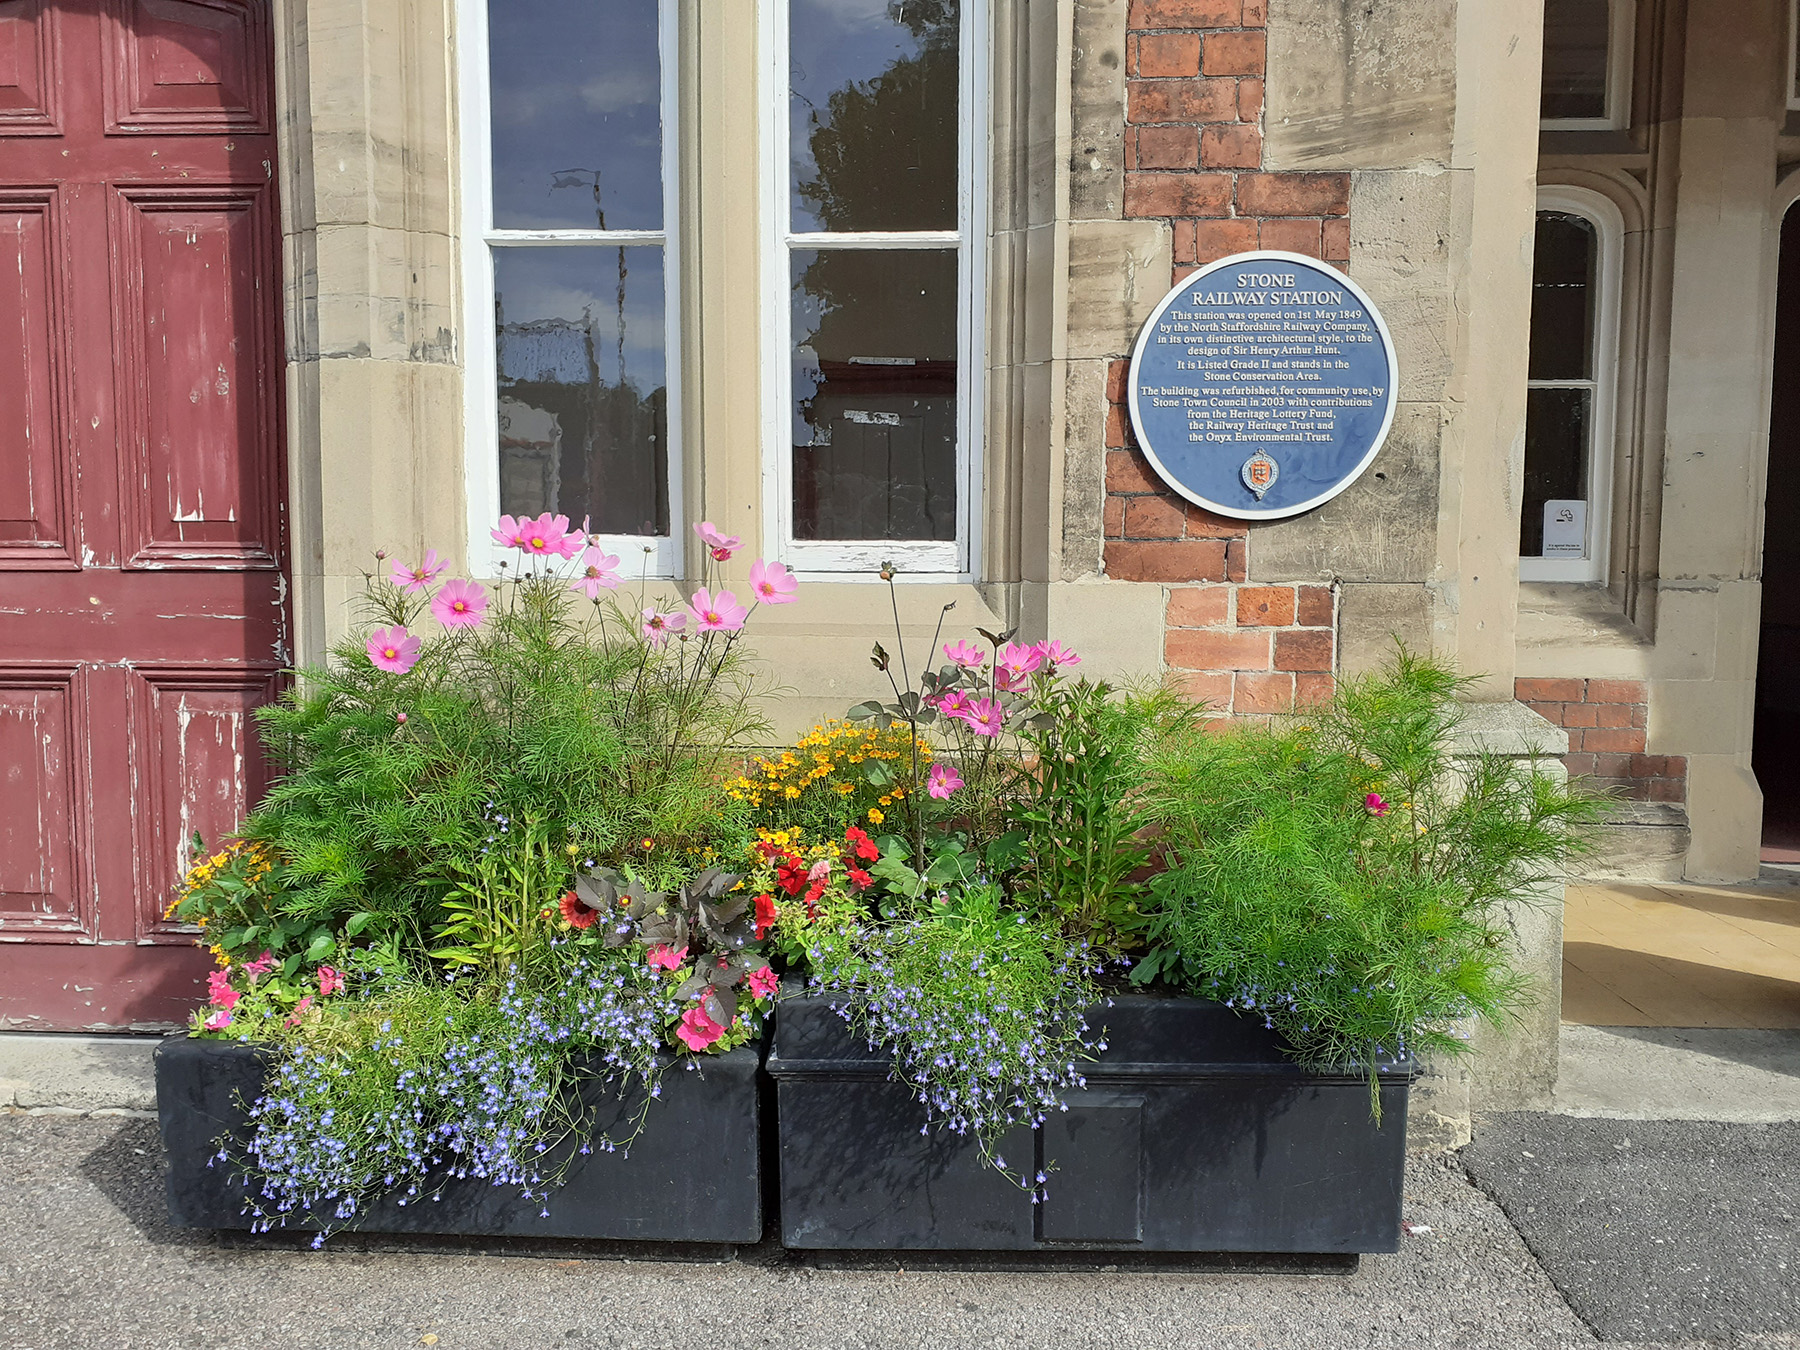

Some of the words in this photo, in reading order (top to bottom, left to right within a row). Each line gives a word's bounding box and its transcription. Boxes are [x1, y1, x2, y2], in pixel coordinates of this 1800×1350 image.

[1237, 274, 1295, 287] STONE
[1192, 292, 1267, 305] RAILWAY
[1271, 291, 1342, 304] STATION
[1171, 311, 1192, 320] This
[1194, 311, 1225, 320] station
[1227, 312, 1245, 320] was
[1248, 310, 1282, 322] opened
[1284, 312, 1296, 320] on
[1298, 310, 1311, 320] 1st
[1315, 310, 1336, 322] May
[1339, 310, 1361, 319] 1849
[1160, 322, 1172, 334] by
[1174, 322, 1189, 332] the
[1191, 322, 1219, 332] North
[1221, 322, 1280, 331] Staffordshire
[1284, 322, 1321, 334] Railway
[1323, 321, 1370, 333] Company,
[1158, 334, 1167, 344] in
[1170, 334, 1181, 343] its
[1207, 334, 1254, 343] distinctive
[1257, 334, 1315, 343] architectural
[1318, 333, 1343, 345] style,
[1346, 333, 1355, 343] to
[1357, 333, 1372, 343] the
[1188, 346, 1218, 357] design
[1221, 346, 1231, 355] of
[1233, 346, 1247, 355] Sir
[1250, 345, 1279, 357] Henry
[1281, 345, 1311, 354] Arthur
[1315, 345, 1340, 354] Hunt.
[1177, 361, 1184, 369] It
[1187, 361, 1195, 369] is
[1198, 361, 1227, 369] Listed
[1230, 360, 1258, 369] Grade
[1261, 360, 1269, 369] II
[1272, 360, 1288, 369] and
[1291, 360, 1320, 369] stands
[1323, 360, 1332, 368] in
[1335, 360, 1349, 368] the
[1204, 372, 1230, 381] Stone
[1233, 372, 1294, 381] Conservation
[1296, 372, 1321, 381] Area.
[1141, 387, 1159, 395] The
[1161, 387, 1199, 398] building
[1222, 387, 1279, 398] refurbished,
[1280, 387, 1294, 395] for
[1296, 386, 1349, 397] community
[1352, 388, 1372, 397] use,
[1372, 386, 1384, 397] by
[1153, 398, 1179, 407] Stone
[1182, 398, 1207, 407] Town
[1210, 398, 1247, 407] Council
[1250, 398, 1259, 407] in
[1261, 398, 1284, 407] 2003
[1287, 398, 1308, 407] with
[1311, 398, 1372, 407] contributions
[1188, 409, 1210, 418] from
[1212, 409, 1227, 418] the
[1230, 409, 1270, 421] Heritage
[1272, 409, 1306, 421] Lottery
[1309, 409, 1336, 421] Fund,
[1189, 421, 1204, 430] the
[1207, 421, 1244, 432] Railway
[1247, 421, 1287, 432] Heritage
[1290, 421, 1314, 430] Trust
[1317, 421, 1333, 430] and
[1189, 433, 1204, 442] the
[1207, 433, 1232, 444] Onyx
[1235, 433, 1302, 442] Environmental
[1305, 433, 1333, 442] Trust.
